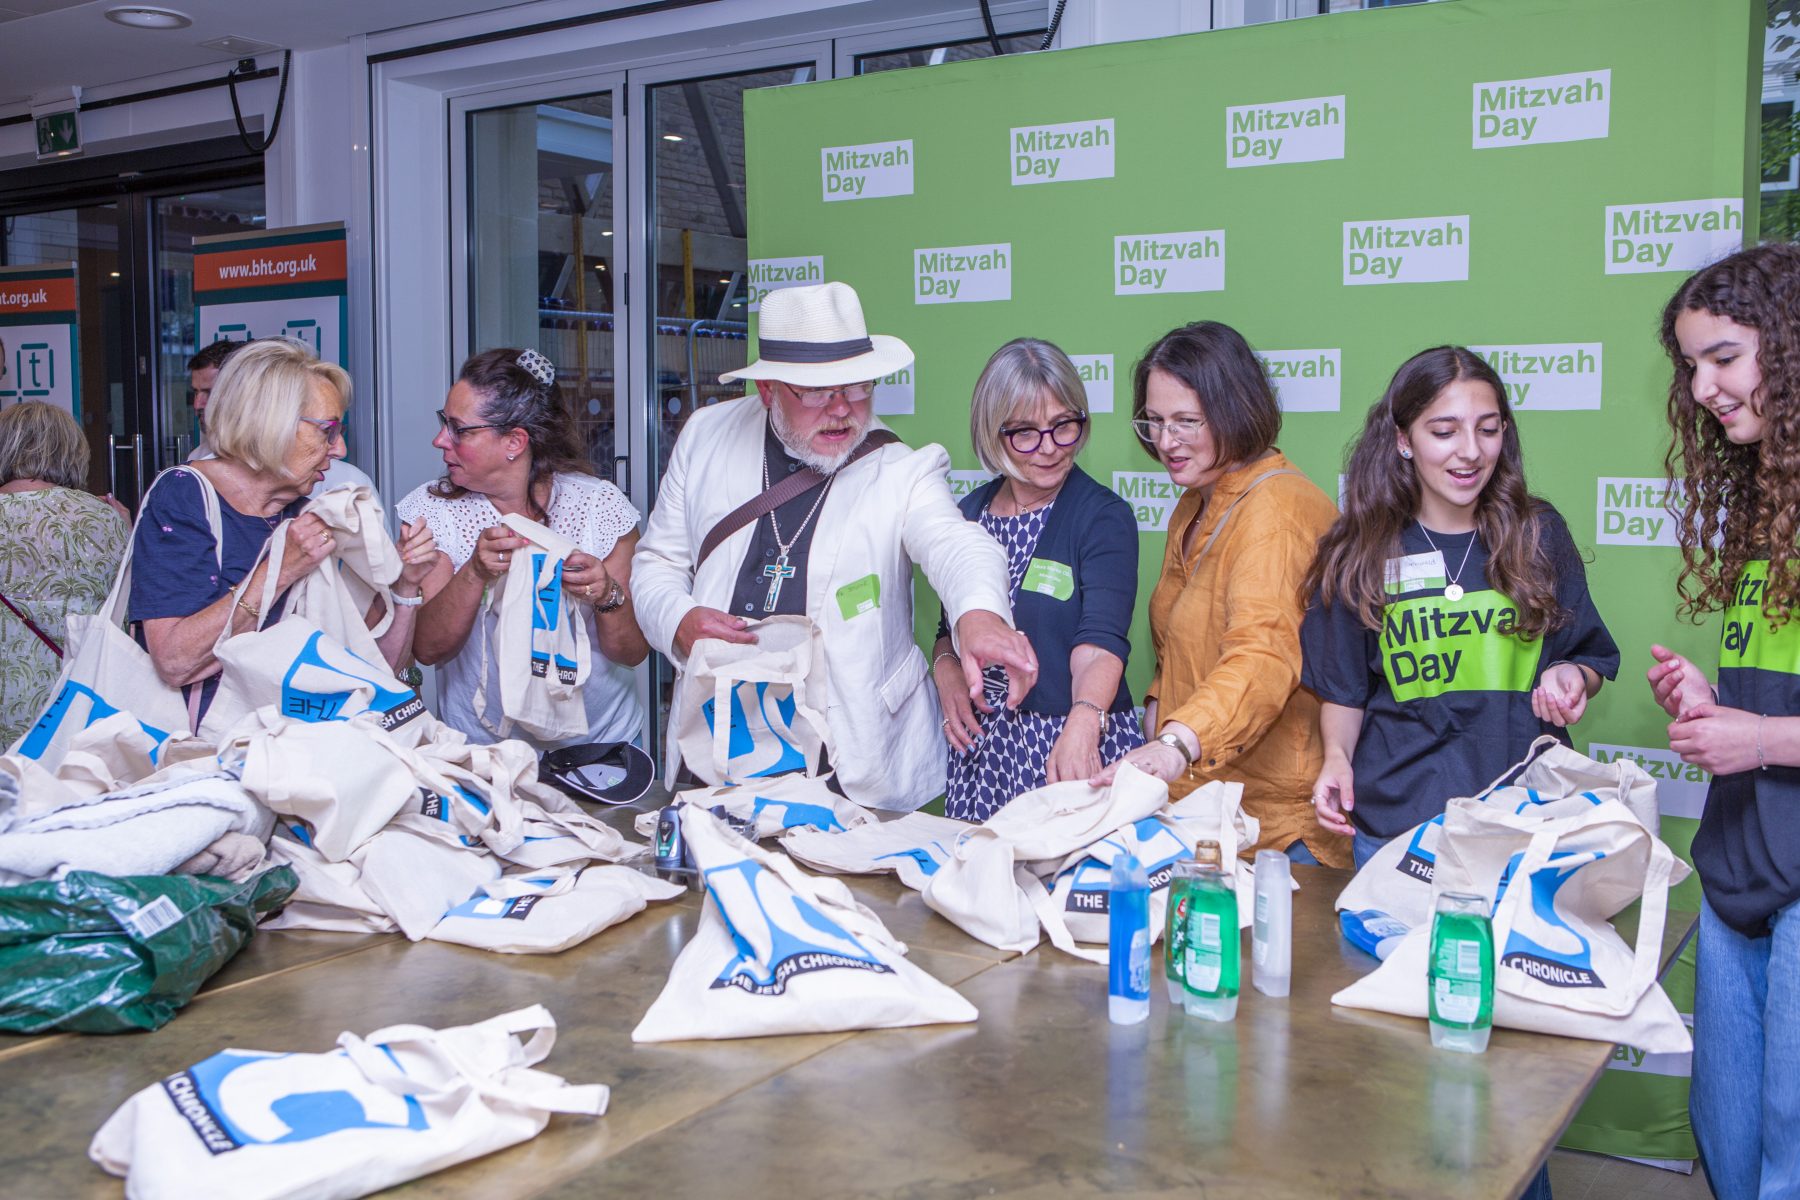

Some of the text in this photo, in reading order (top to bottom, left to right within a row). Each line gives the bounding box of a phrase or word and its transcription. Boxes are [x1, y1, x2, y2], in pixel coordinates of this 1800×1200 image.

[1480, 78, 1603, 112] Mitzvah
[1232, 103, 1340, 134] Mitzvah
[1479, 115, 1538, 140] Day
[1015, 126, 1110, 153] Mitzvah
[1232, 136, 1283, 160] Day
[826, 146, 909, 172] Mitzvah
[1016, 155, 1061, 178] Day
[827, 174, 866, 195] Day
[1613, 205, 1742, 236] Mitzvah
[1119, 236, 1220, 262] Mitzvah
[1349, 223, 1463, 250] Mitzvah
[919, 249, 1007, 274] Mitzvah
[1349, 252, 1403, 279] Day
[1612, 239, 1674, 267] Day
[219, 254, 317, 279] www.bht.org.uk
[748, 261, 820, 283] Mitzvah
[1120, 264, 1167, 289] Day
[748, 285, 769, 305] Da
[919, 276, 961, 299] Day
[1262, 354, 1335, 378] tzvah
[1119, 477, 1183, 499] Mitzv
[1604, 483, 1688, 509] Mitzv
[1131, 501, 1165, 527] ay
[1603, 511, 1664, 541] Day
[1385, 607, 1517, 649] Mitzva
[1722, 621, 1754, 658] ay
[1390, 650, 1462, 686] Day
[289, 696, 337, 721] THE
[425, 792, 438, 816] THE
[1074, 893, 1103, 909] THE
[1510, 957, 1592, 984] CHRONICLE
[1612, 1043, 1646, 1068] ay
